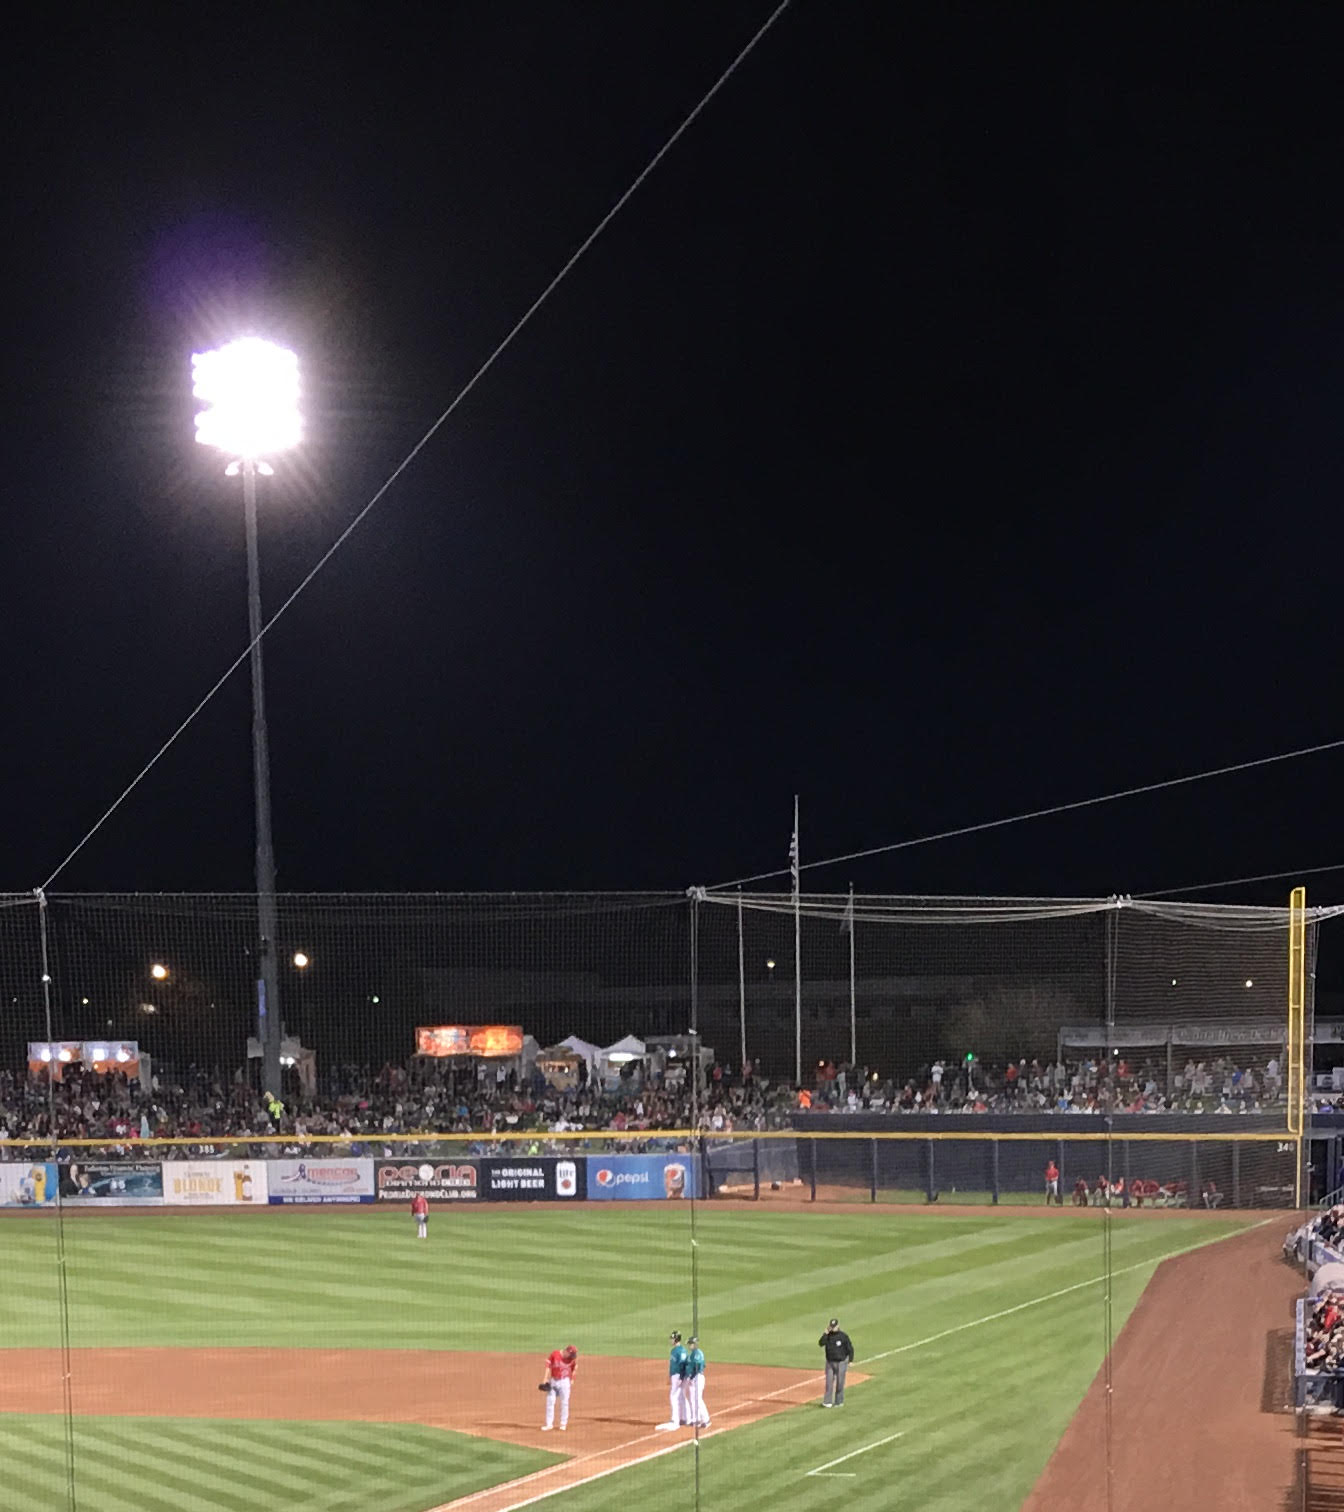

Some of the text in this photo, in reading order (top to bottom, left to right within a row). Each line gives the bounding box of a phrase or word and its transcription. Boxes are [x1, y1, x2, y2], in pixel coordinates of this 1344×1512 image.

[502, 1168, 544, 1177] ORIGINAL
[616, 1171, 649, 1185] pepsi
[491, 1179, 545, 1188] LIGHT BEER
